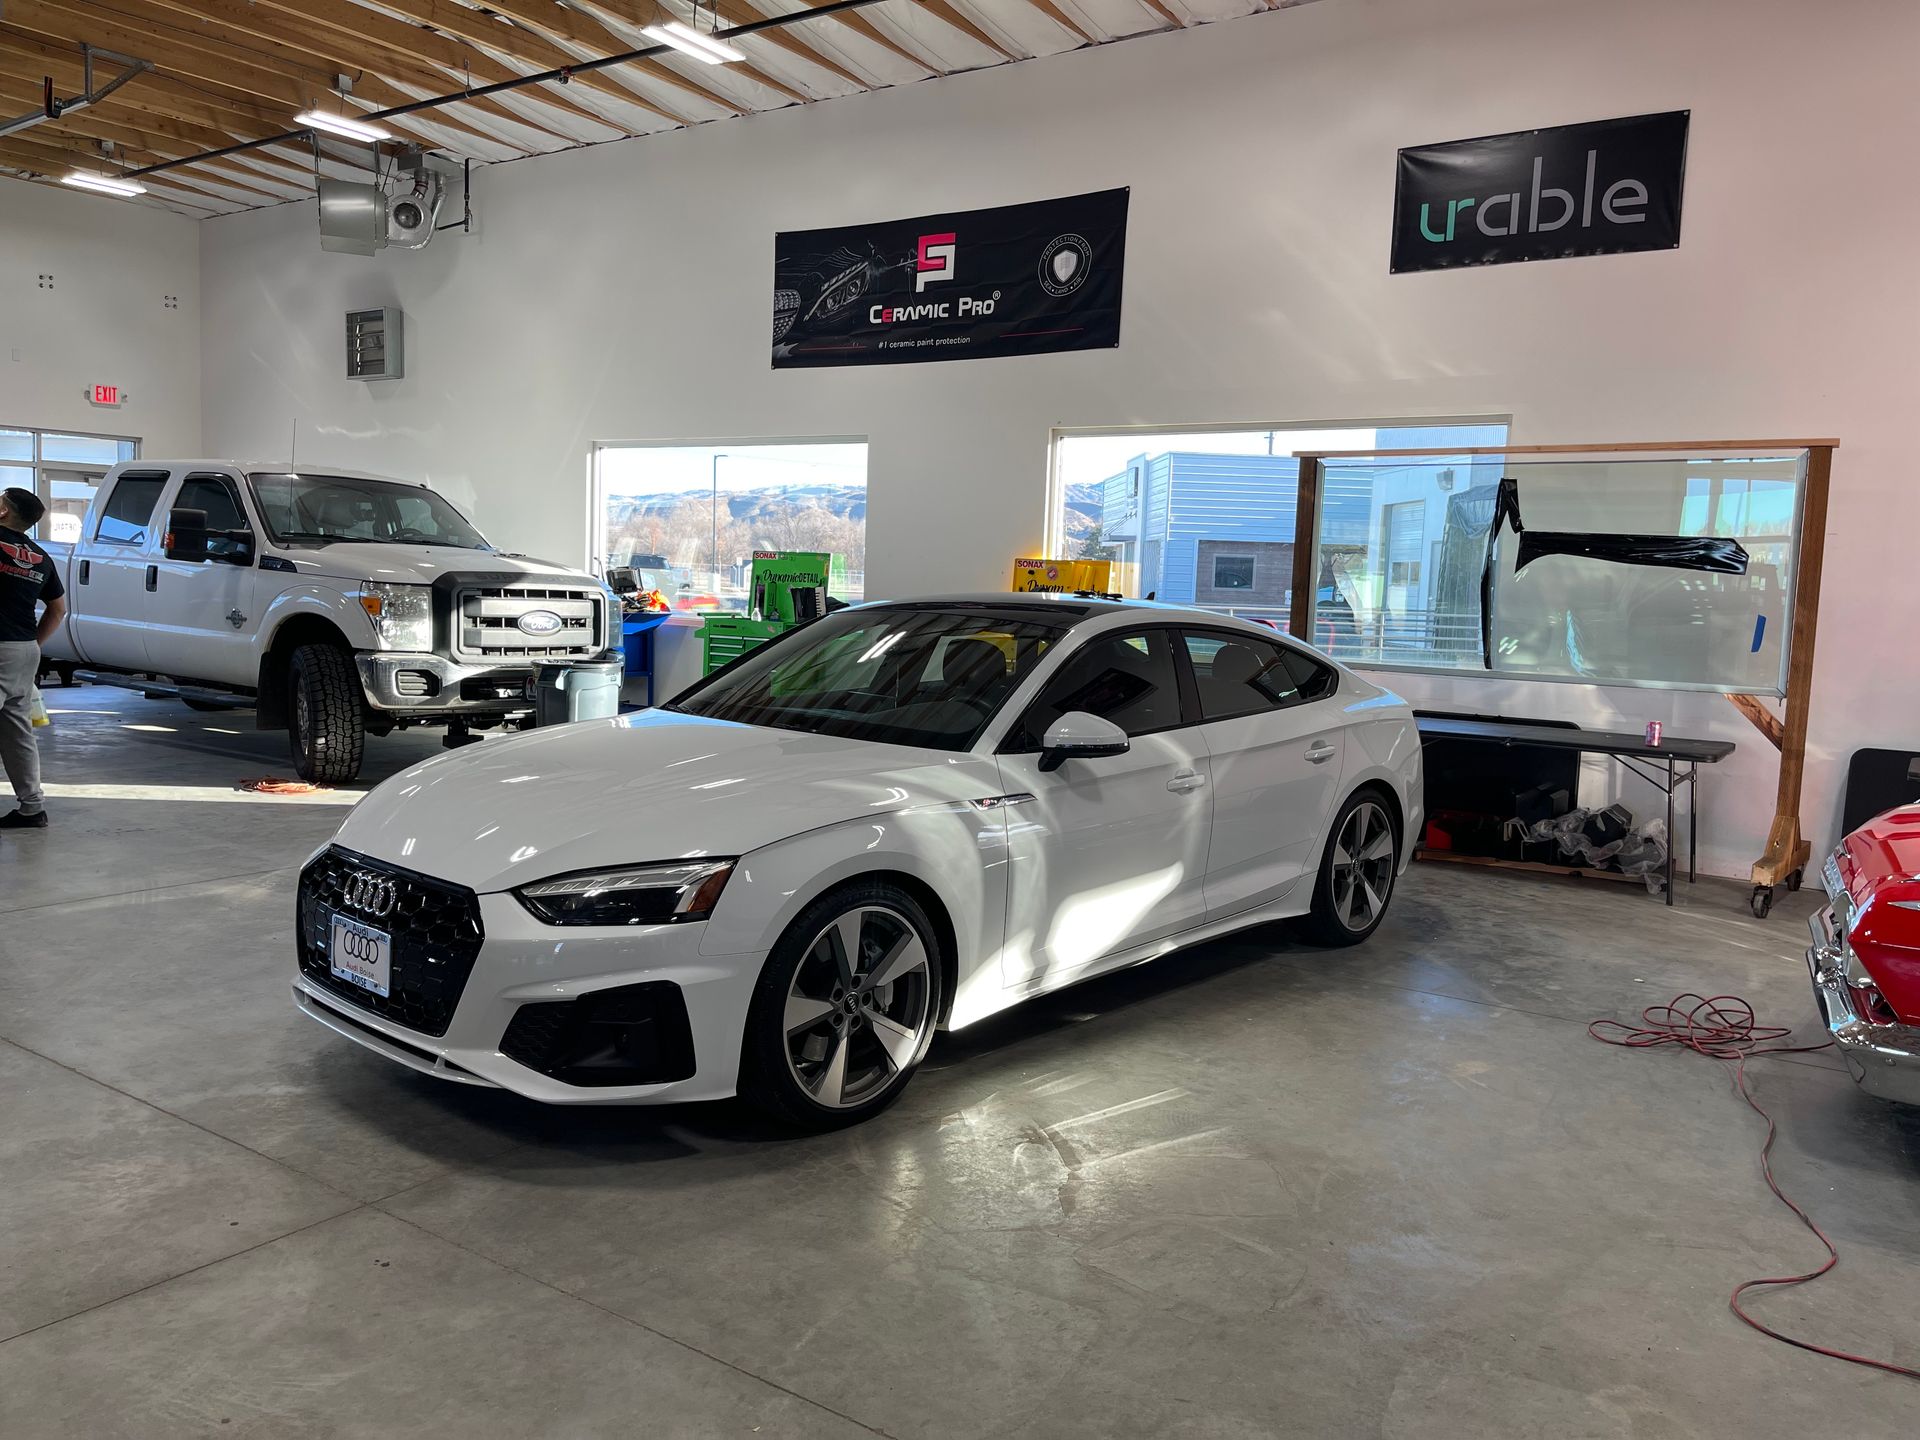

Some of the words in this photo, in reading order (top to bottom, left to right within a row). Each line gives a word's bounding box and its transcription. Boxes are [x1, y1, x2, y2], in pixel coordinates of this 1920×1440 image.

[1420, 150, 1649, 243] urable
[1043, 236, 1079, 260] PROTECTION
[1078, 239, 1090, 257] FROM
[878, 340, 888, 349] #1
[889, 338, 915, 349] ceramic
[916, 337, 934, 348] paint
[935, 335, 971, 347] protection
[95, 385, 117, 403] EXIT
[755, 552, 777, 560] SONAX
[1017, 560, 1044, 569] SONAX
[352, 924, 369, 937] Audi
[346, 961, 359, 971] Audi
[359, 967, 375, 978] Boise
[351, 973, 367, 988] BOISE
